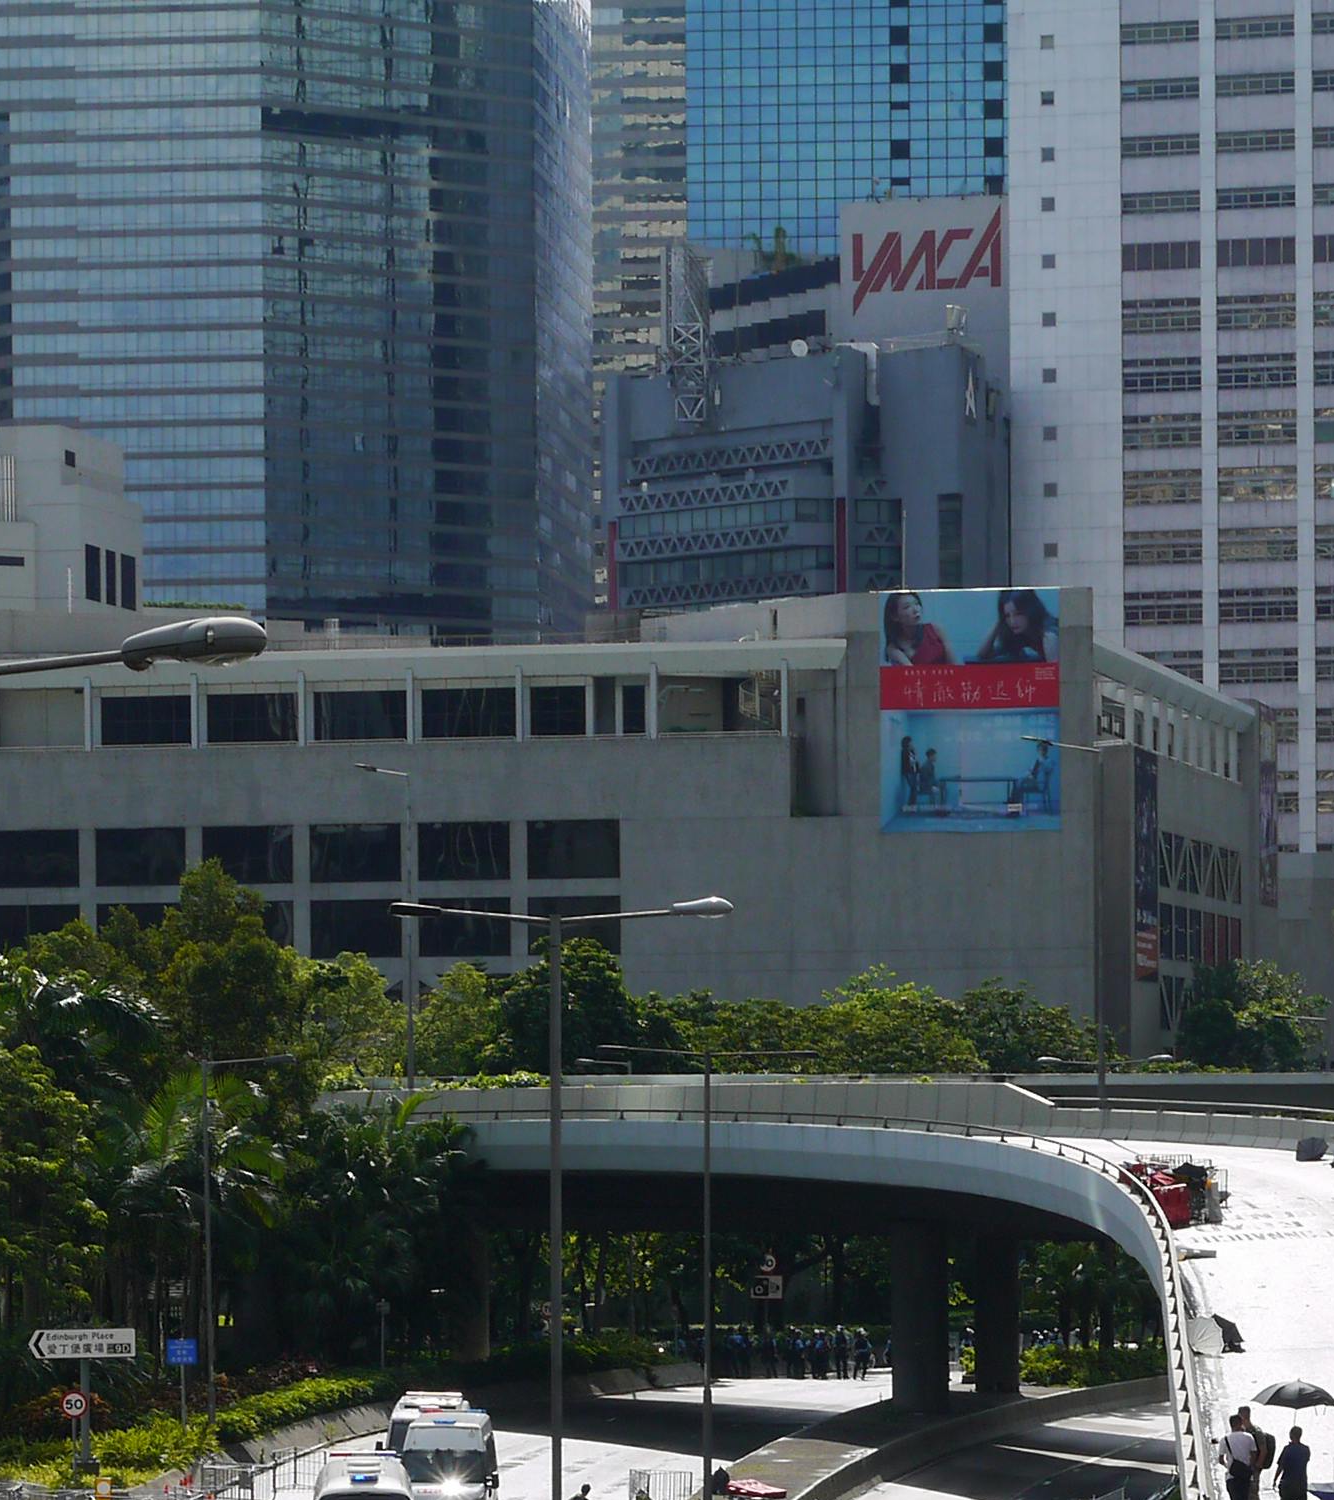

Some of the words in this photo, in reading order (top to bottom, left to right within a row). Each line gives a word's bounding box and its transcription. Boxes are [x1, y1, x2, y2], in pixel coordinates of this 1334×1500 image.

[850, 207, 1002, 316] YMCA
[46, 1333, 88, 1342] Edinburgh
[91, 1332, 114, 1340] Place
[65, 1400, 84, 1410] 50
